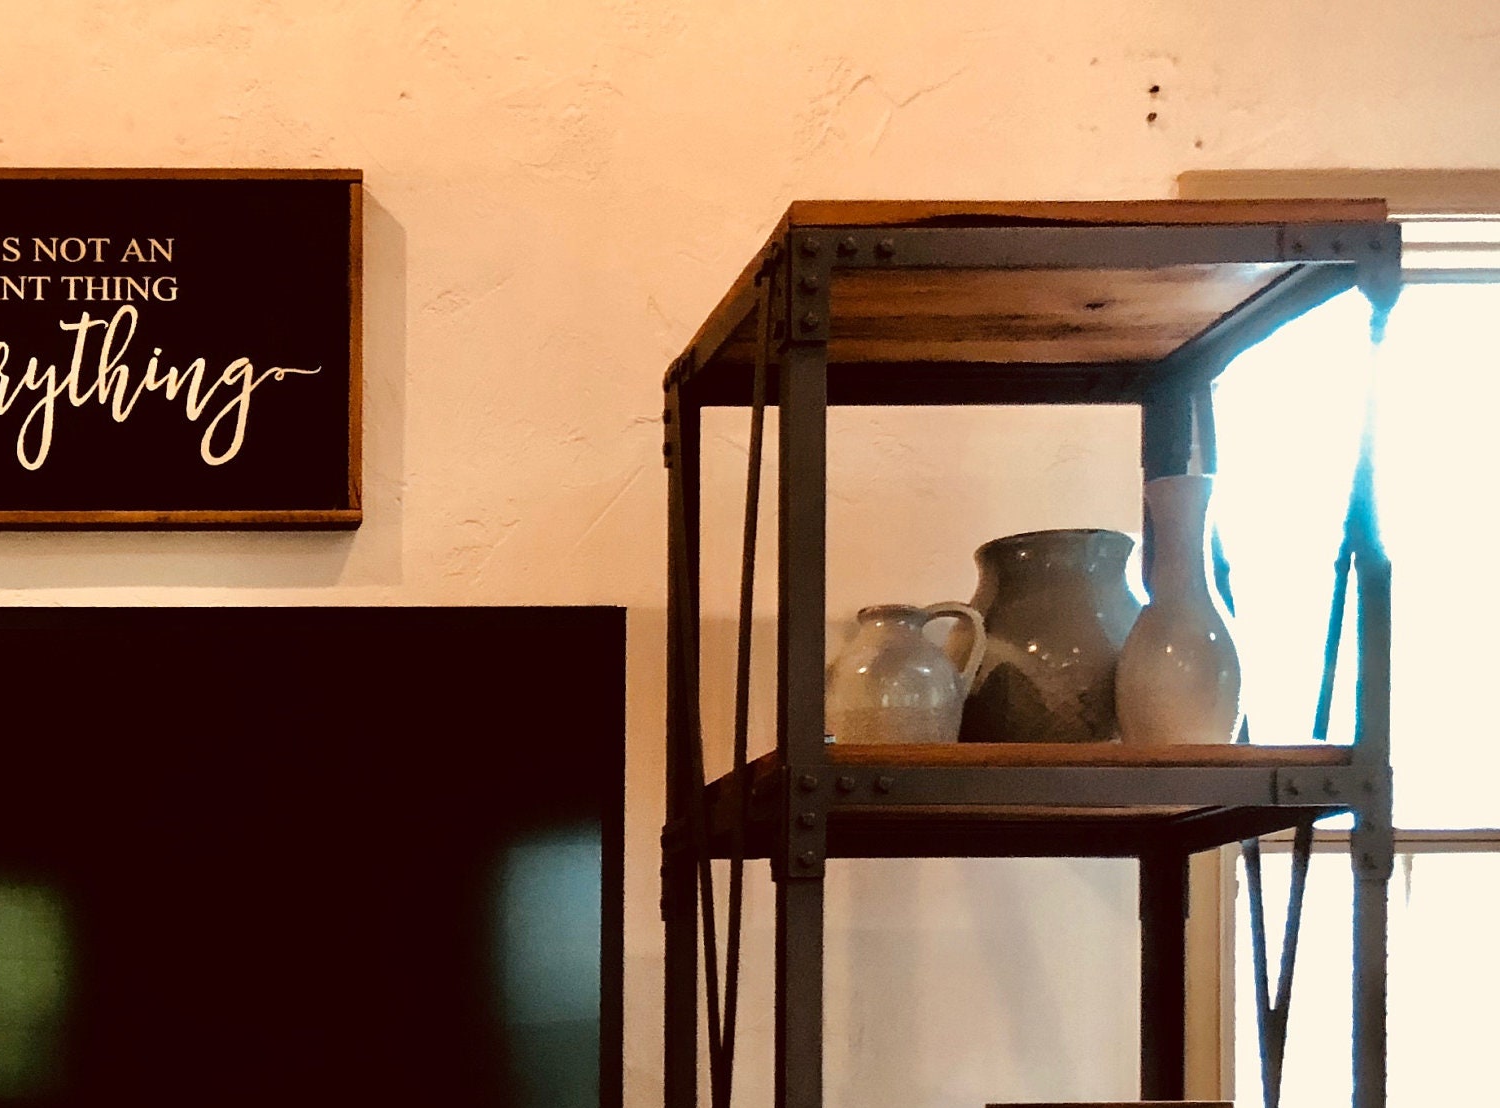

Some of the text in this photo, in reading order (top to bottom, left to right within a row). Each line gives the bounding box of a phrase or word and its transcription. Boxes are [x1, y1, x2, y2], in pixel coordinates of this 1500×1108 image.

[31, 237, 111, 263] NOT
[120, 238, 175, 263] AN
[60, 275, 179, 302] THING
